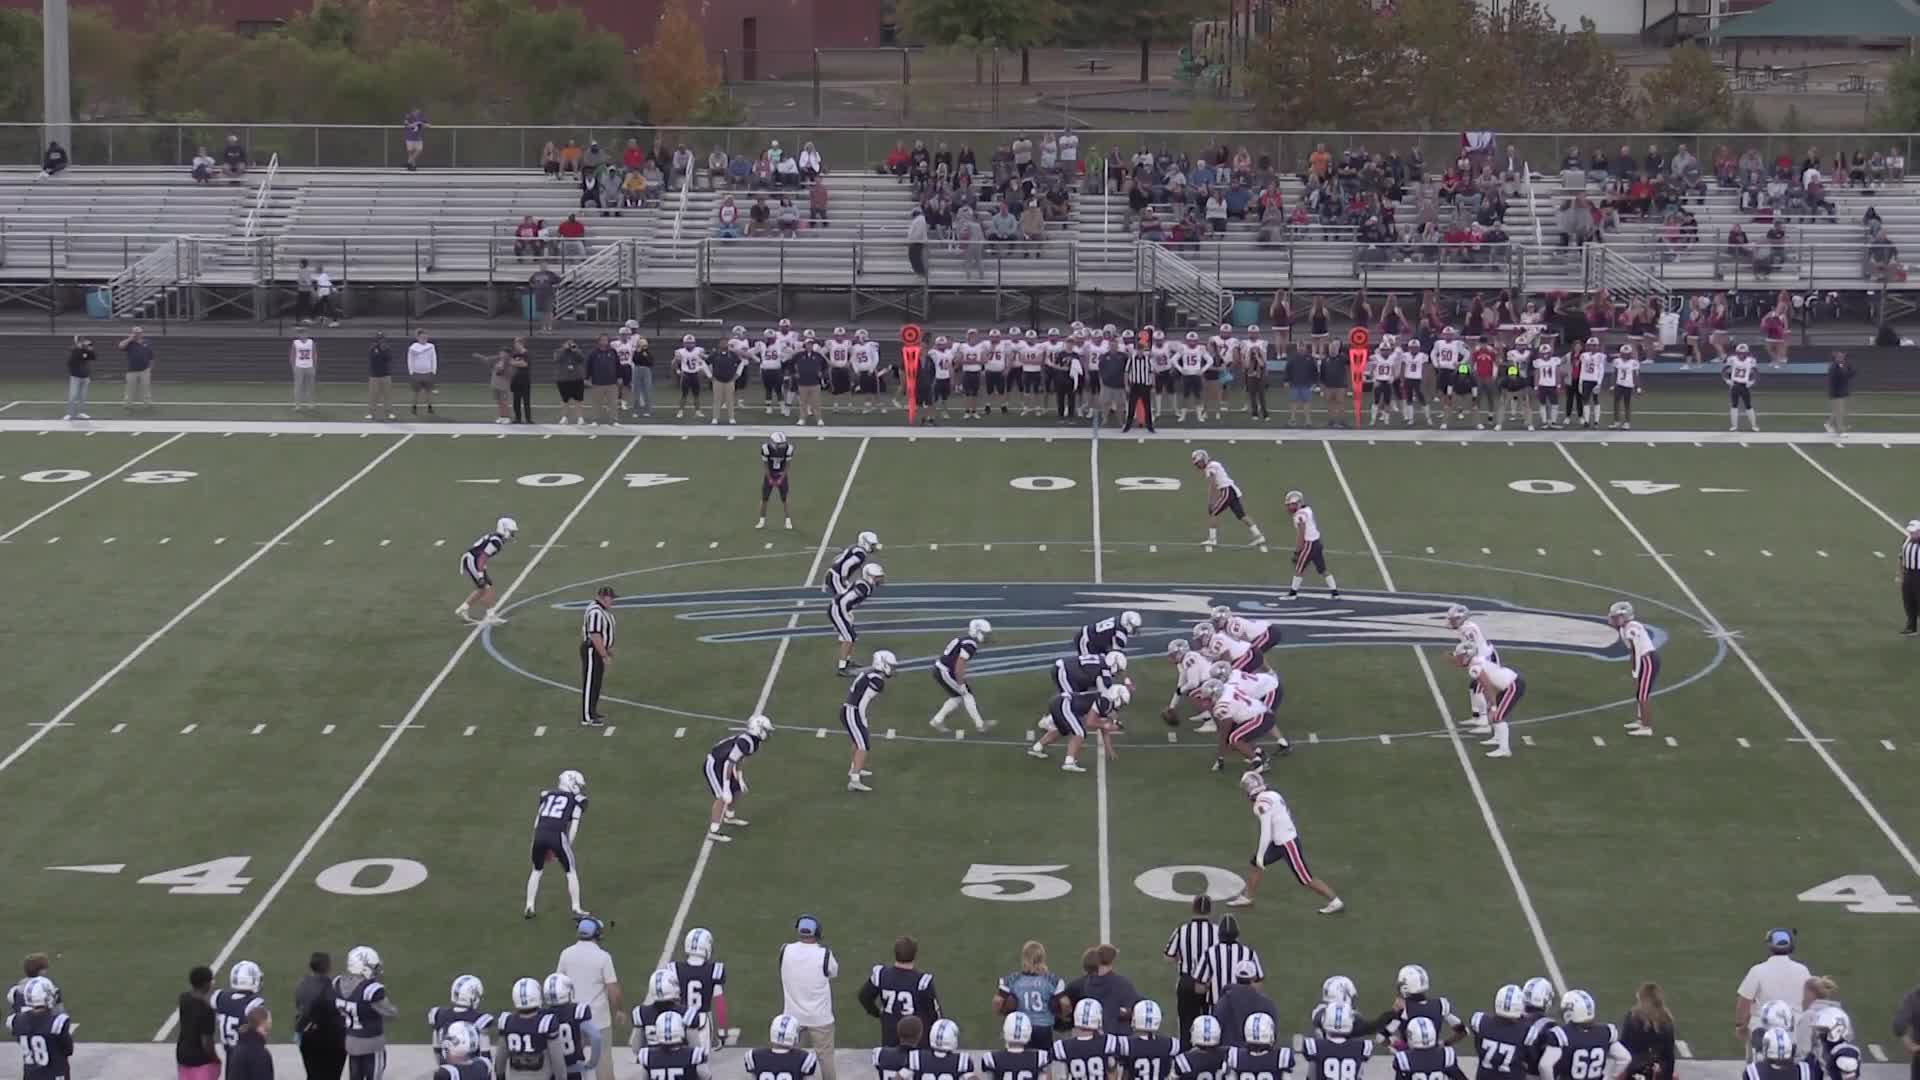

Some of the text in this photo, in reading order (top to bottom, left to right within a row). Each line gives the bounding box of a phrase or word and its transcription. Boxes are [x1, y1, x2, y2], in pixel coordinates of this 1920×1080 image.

[541, 794, 569, 819] 12
[687, 980, 703, 1010] 6
[881, 989, 915, 1016] 73
[1023, 991, 1043, 1012] 13
[1481, 1037, 1516, 1072] 77
[1571, 1047, 1605, 1080] 62
